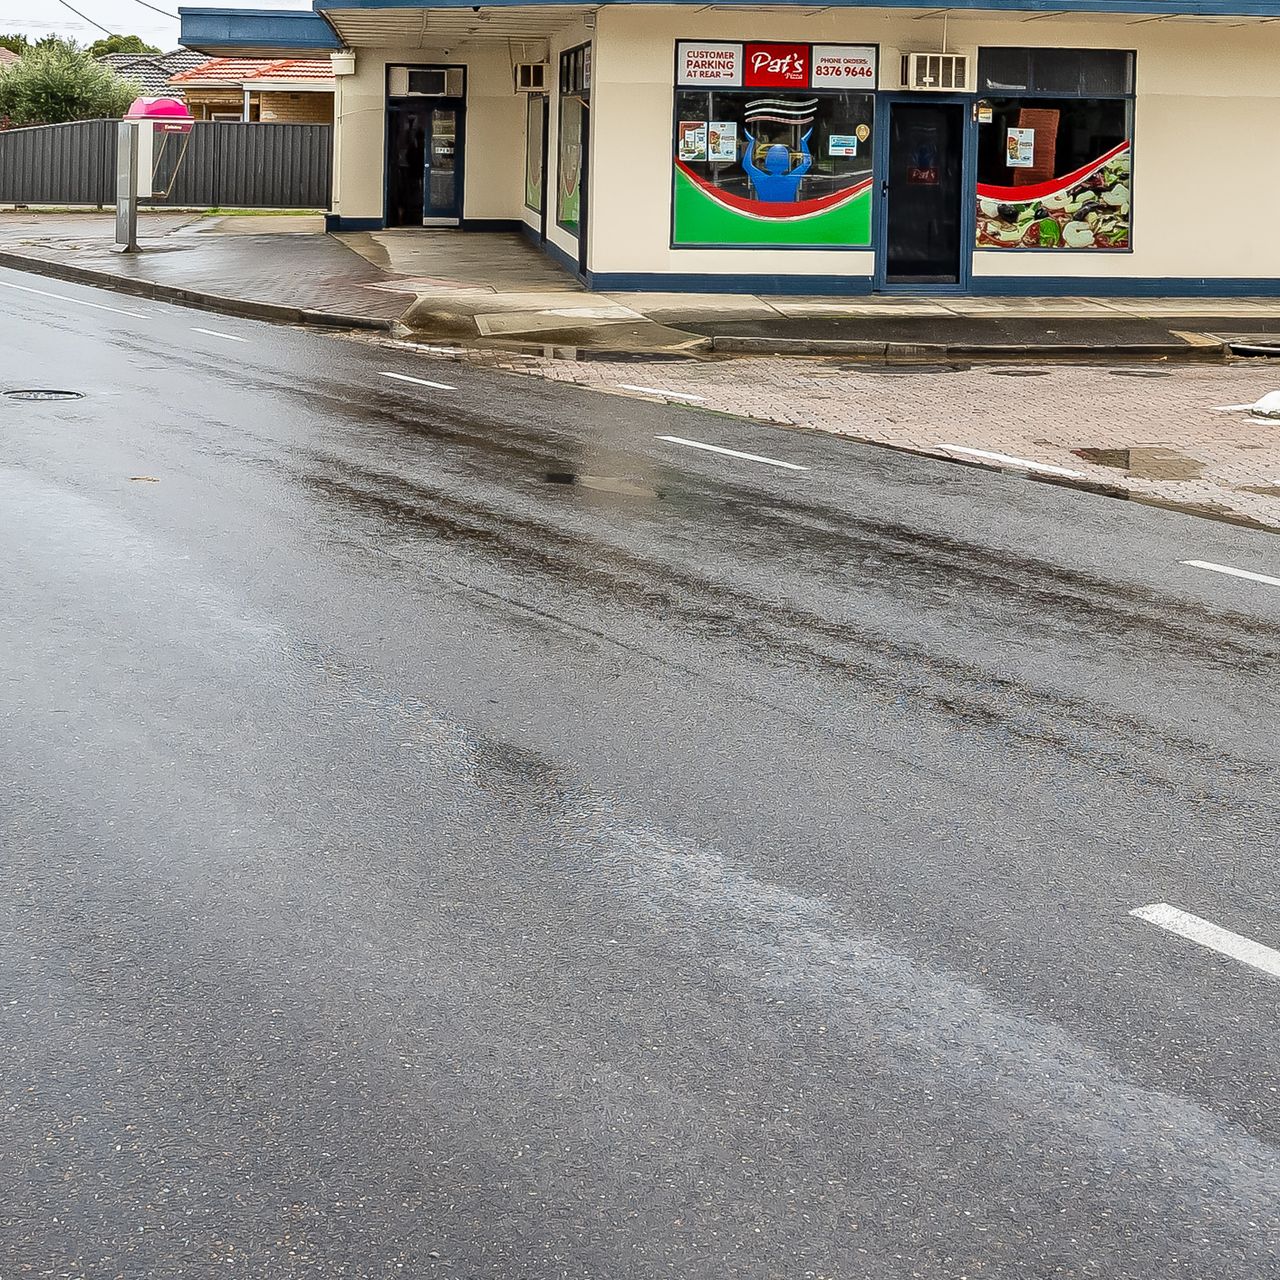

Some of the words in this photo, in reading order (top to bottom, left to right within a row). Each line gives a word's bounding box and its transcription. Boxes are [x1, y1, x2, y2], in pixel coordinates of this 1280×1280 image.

[687, 50, 734, 60] CUSTOMER
[686, 60, 734, 70] PARKING
[751, 51, 804, 74] Pat's
[686, 70, 697, 78] AT
[815, 65, 842, 77] 8376
[844, 66, 873, 77] 9646
